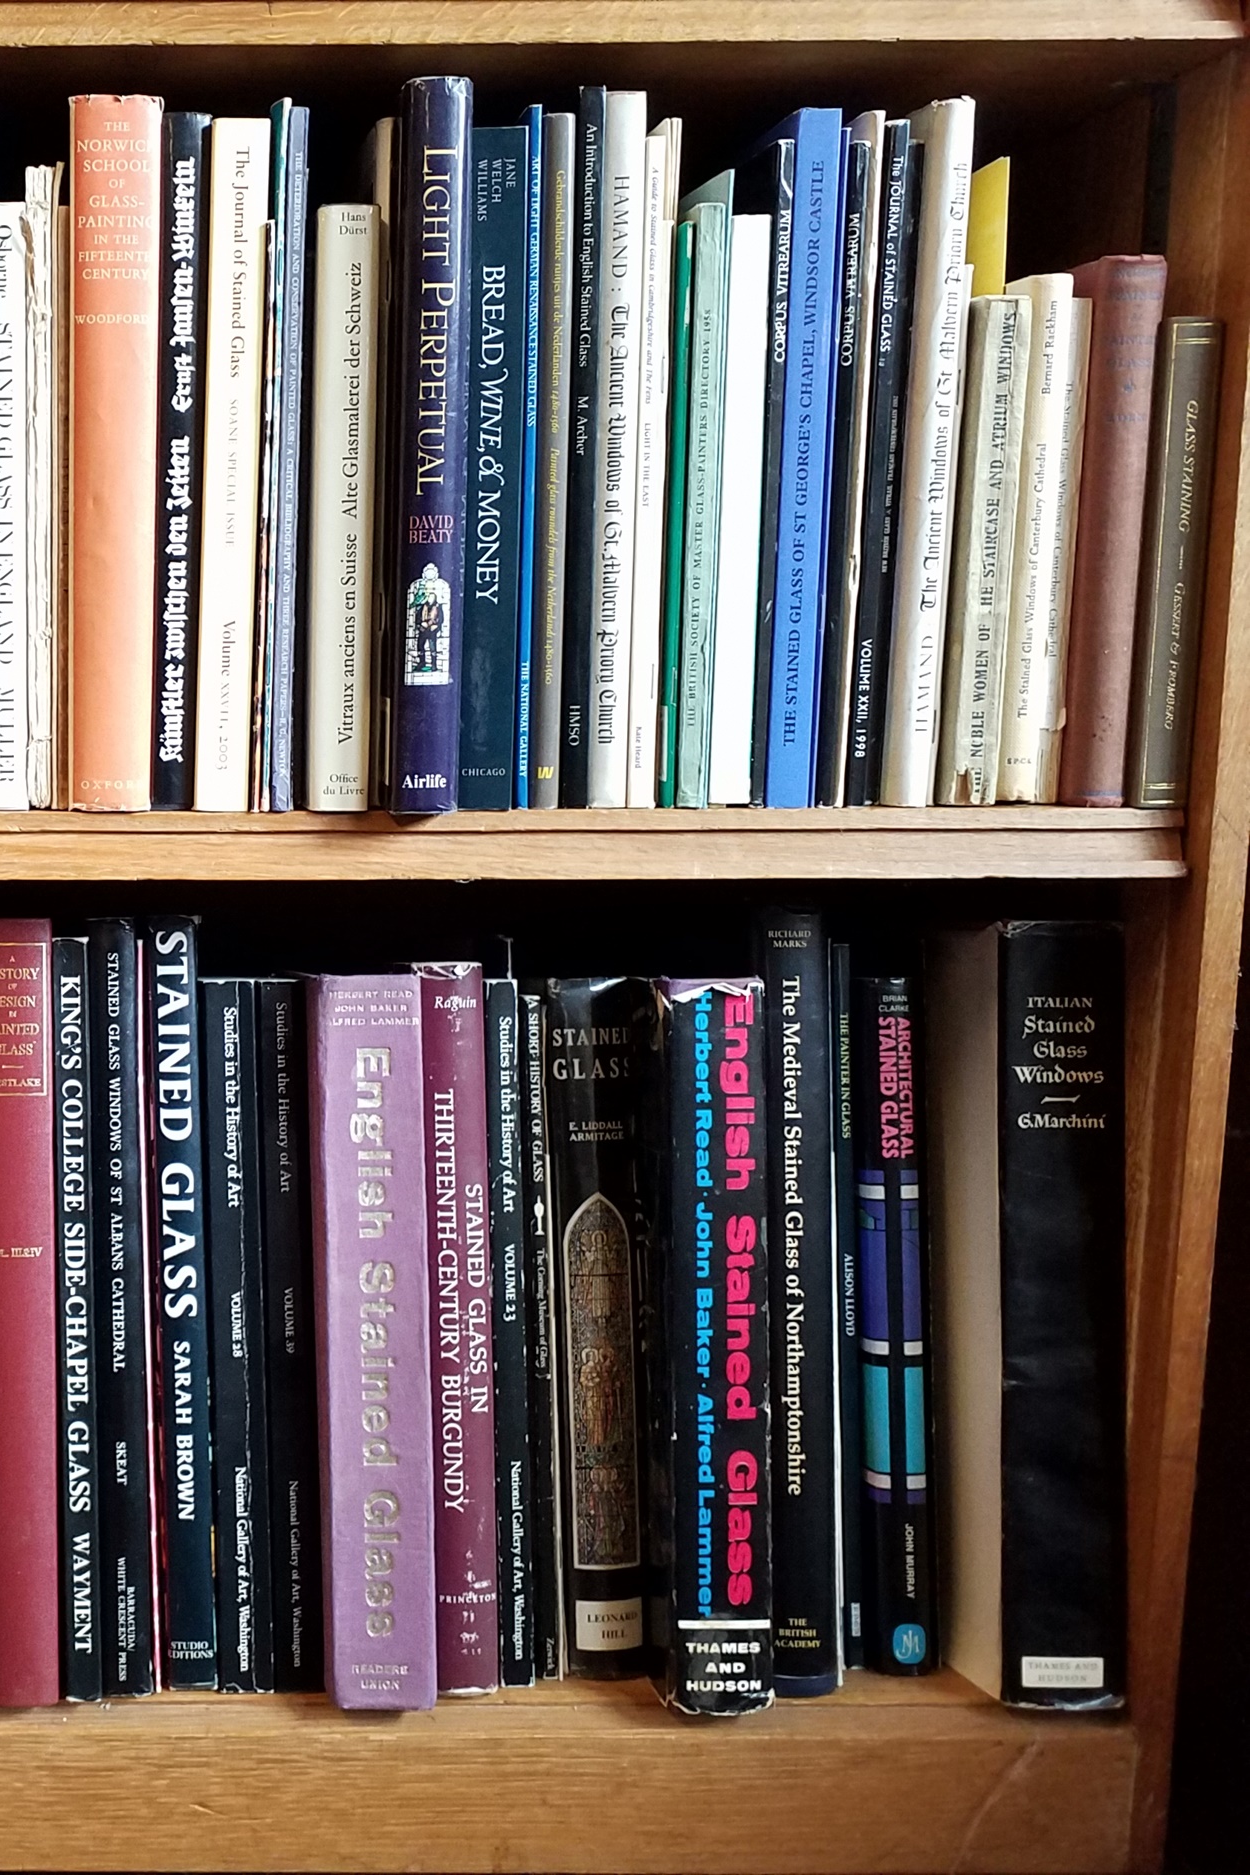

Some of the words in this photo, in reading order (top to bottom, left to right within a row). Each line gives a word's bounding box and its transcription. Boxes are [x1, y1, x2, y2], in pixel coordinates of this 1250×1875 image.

[235, 146, 250, 178] The
[586, 123, 598, 142] An
[231, 183, 249, 243] Journal
[421, 145, 458, 266] LIGHT
[582, 144, 597, 219] Introduction
[810, 160, 825, 234] CASTLE
[233, 250, 247, 267] of
[579, 238, 593, 283] English
[582, 222, 593, 235] to
[230, 271, 247, 330] Stained
[478, 265, 506, 368] BREAD,
[578, 286, 592, 331] Stained
[803, 238, 821, 326] WINDSOR
[230, 336, 244, 378] Glass
[416, 279, 456, 495] PERPETUAL
[578, 334, 590, 367] Glass
[799, 329, 817, 409] CHAPEL,
[476, 369, 508, 452] WINE,
[1183, 400, 1199, 452] GLASS
[479, 455, 504, 486] &
[1178, 456, 1197, 533] STAINING
[475, 490, 501, 604] MONEY
[792, 538, 806, 562] OF
[794, 511, 807, 533] ST
[789, 568, 804, 624] GLASS
[785, 629, 801, 705] STAINED
[783, 710, 798, 746] THE
[60, 975, 82, 1070] KING'S
[782, 976, 801, 1016] The
[1022, 1015, 1095, 1039] Stained
[1027, 997, 1092, 1008] ITALIAN
[156, 930, 192, 1142] STAINED
[783, 1023, 802, 1120] Medieval
[878, 1016, 899, 1095] STAINED
[1012, 1064, 1104, 1083] Windows
[1033, 1039, 1087, 1058] Glass
[719, 993, 755, 1190] English
[897, 1017, 914, 1159] ARCHITECTURAL
[61, 1079, 85, 1211] COLLEGE
[350, 1047, 394, 1239] English
[784, 1126, 802, 1205] Stained
[881, 1101, 899, 1159] GLASS
[161, 1163, 197, 1318] GLASS
[434, 1089, 460, 1363] THIRTEENTH-CENTURY
[465, 1185, 484, 1288] STAINED
[785, 1211, 803, 1268] Glass
[64, 1222, 89, 1412] SIDE-CHAPEL
[726, 1215, 757, 1420] Stained
[785, 1275, 805, 1296] of
[359, 1262, 398, 1467] Stained
[469, 1298, 488, 1374] GLASS
[173, 1340, 192, 1424] SARAH
[470, 1386, 488, 1413] IN
[782, 1302, 806, 1496] Northamptonshire
[68, 1421, 91, 1513] GLASS
[176, 1435, 194, 1520] BROWN
[441, 1375, 464, 1513] BURGUNDY
[364, 1490, 400, 1639] Glass
[727, 1451, 757, 1606] Glass
[73, 1533, 92, 1654] WAYMENT
[686, 1642, 760, 1653] THAMES
[705, 1663, 745, 1674] AND
[686, 1681, 761, 1691] HUDSON
